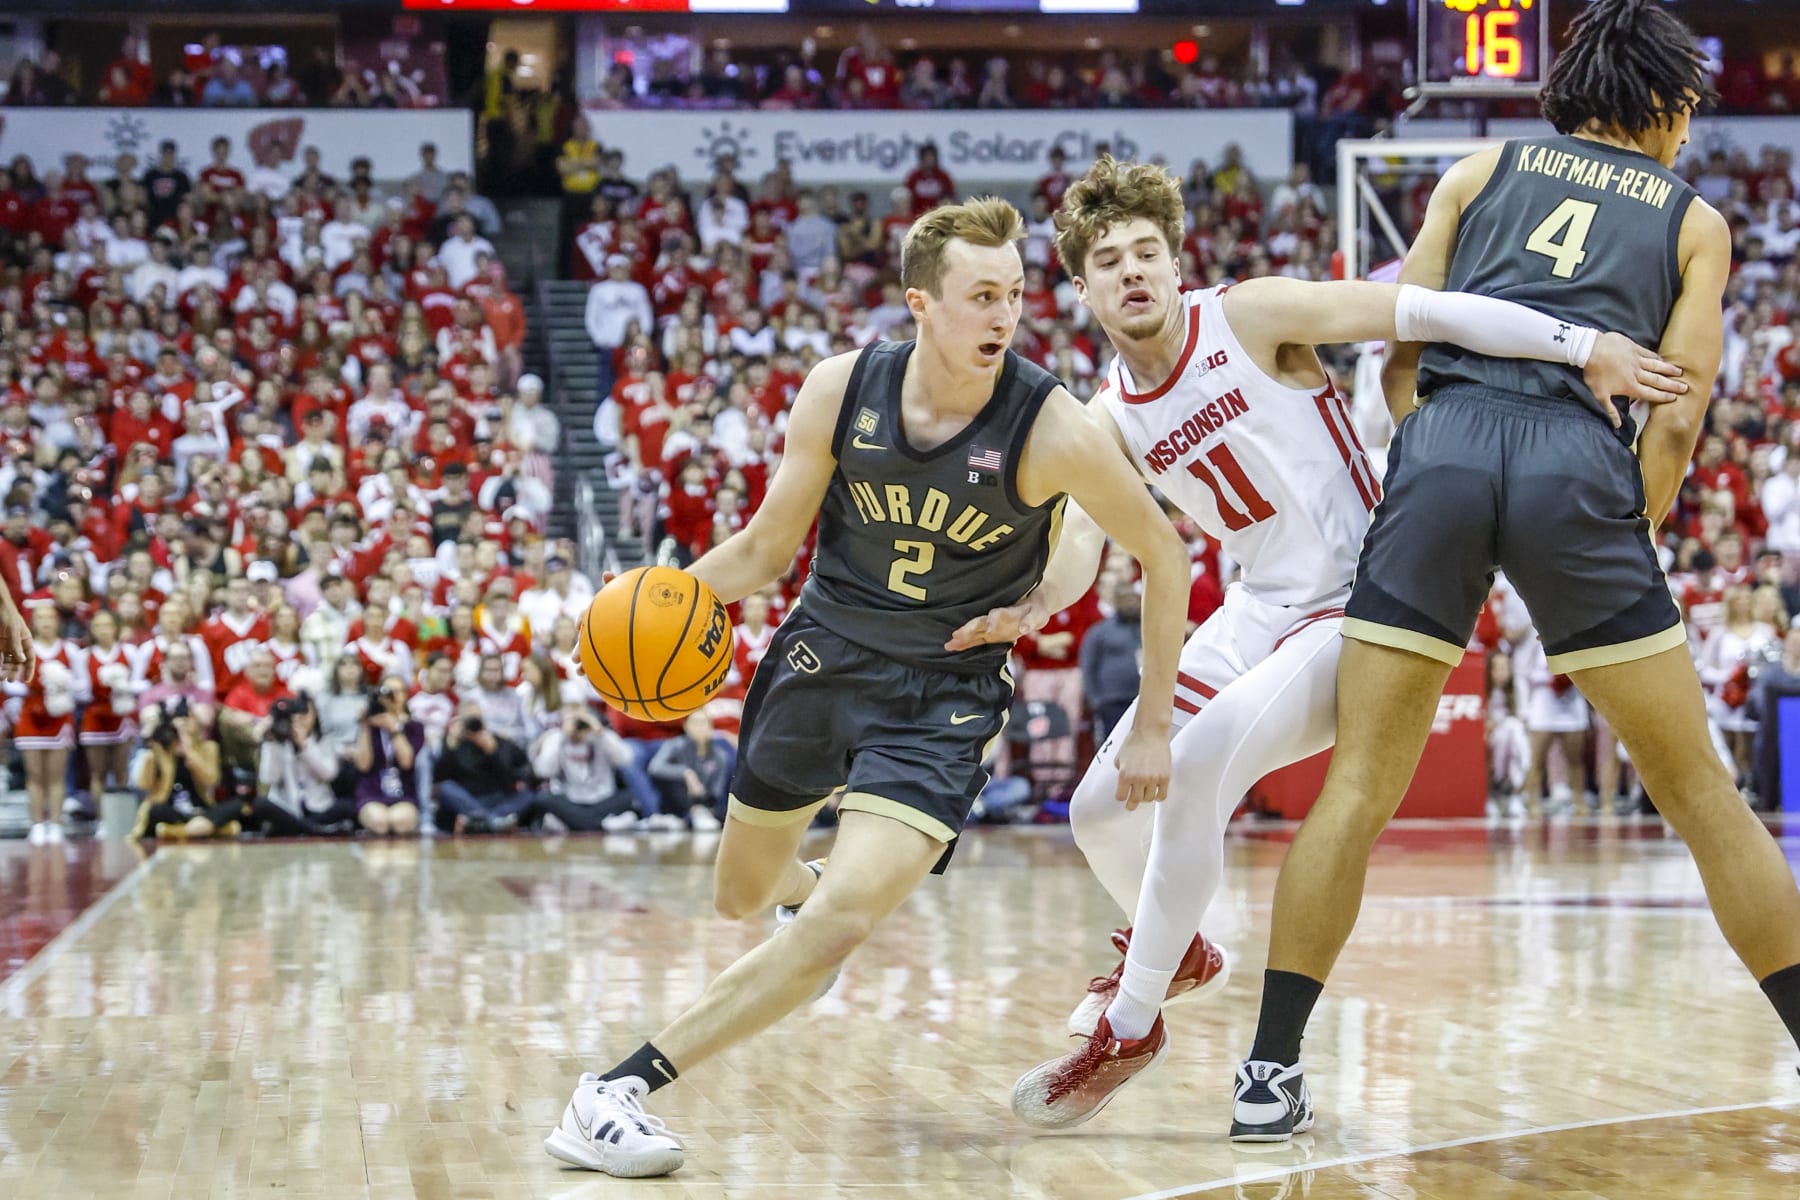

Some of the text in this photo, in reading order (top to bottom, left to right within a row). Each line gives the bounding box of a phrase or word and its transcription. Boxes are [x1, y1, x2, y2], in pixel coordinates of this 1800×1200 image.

[1465, 10, 1522, 77] 16
[949, 130, 1045, 164] Solar
[1517, 145, 1673, 210] KAUFMAN-RENN
[1525, 197, 1600, 279] 4
[848, 481, 1015, 552] PURDUE
[1186, 441, 1277, 532] 11
[887, 539, 935, 601] 2
